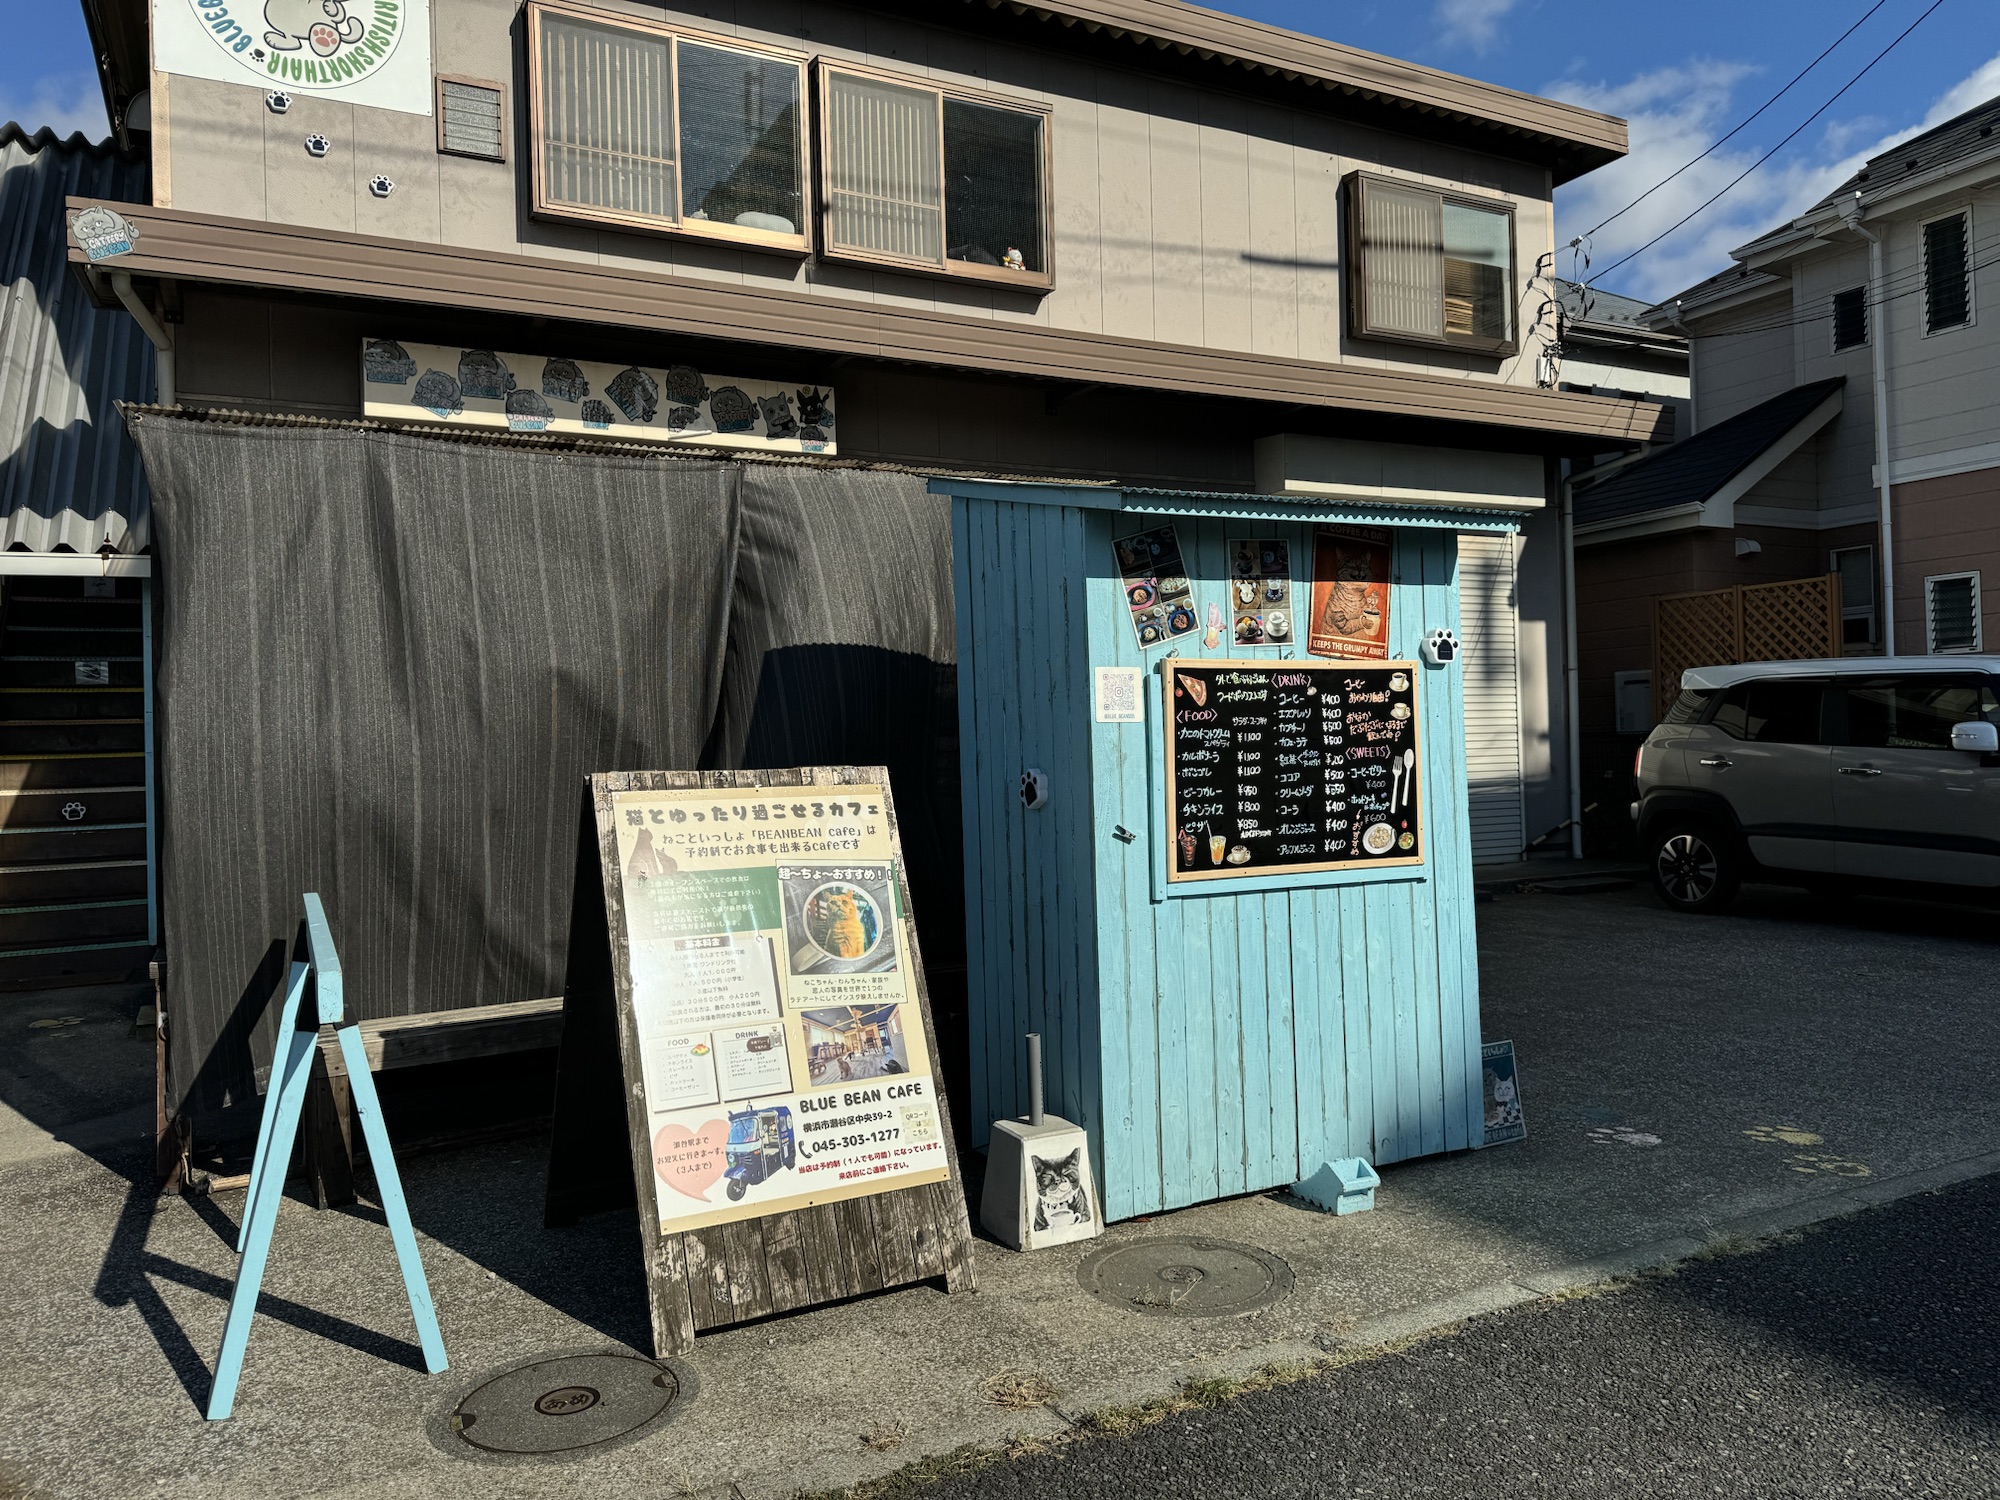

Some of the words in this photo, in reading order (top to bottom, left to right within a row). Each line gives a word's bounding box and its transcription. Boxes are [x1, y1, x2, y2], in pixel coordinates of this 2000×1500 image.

[88, 231, 124, 249] CATTERY
[1329, 524, 1361, 536] COFFEE
[1371, 531, 1388, 541] DAY
[1312, 639, 1331, 650] KEEPS
[1332, 641, 1343, 651] THE
[1343, 643, 1368, 654] GRUMPY
[1369, 646, 1386, 657] AWAY
[1279, 693, 1305, 706] コーヒー
[1321, 693, 1340, 705] ¥400
[1322, 721, 1342, 732] ¥500
[1323, 734, 1343, 745] ¥500
[1280, 772, 1300, 783] ココア
[1325, 768, 1344, 780] ¥500
[1183, 786, 1223, 798] ビーフカレー
[626, 802, 879, 826] 猫とゆったり過ごせるカフェ
[1183, 802, 1224, 816] チキンライス
[1238, 801, 1260, 813] ¥800
[1280, 804, 1299, 815] コーラ
[1325, 800, 1346, 812] ¥400
[1237, 818, 1258, 831] ¥850
[1325, 818, 1347, 832] ¥400
[685, 839, 860, 858] 予約制でお食事も出来るcafeです
[1324, 838, 1346, 852] ¥400
[685, 937, 721, 949] 基本料金
[735, 1030, 759, 1040] DRINK
[667, 1038, 690, 1047] FOOD
[799, 1095, 838, 1114] BLUE
[843, 1088, 882, 1107] BEAN
[887, 1083, 923, 1099] CAFE
[803, 1110, 893, 1133] 横浜市瀬谷区中央39-2
[905, 1111, 929, 1121] QRコード
[912, 1128, 929, 1137] こちら
[812, 1128, 900, 1153] 045-303-1277
[838, 1161, 910, 1181] 来店前にご連絡下さい。
